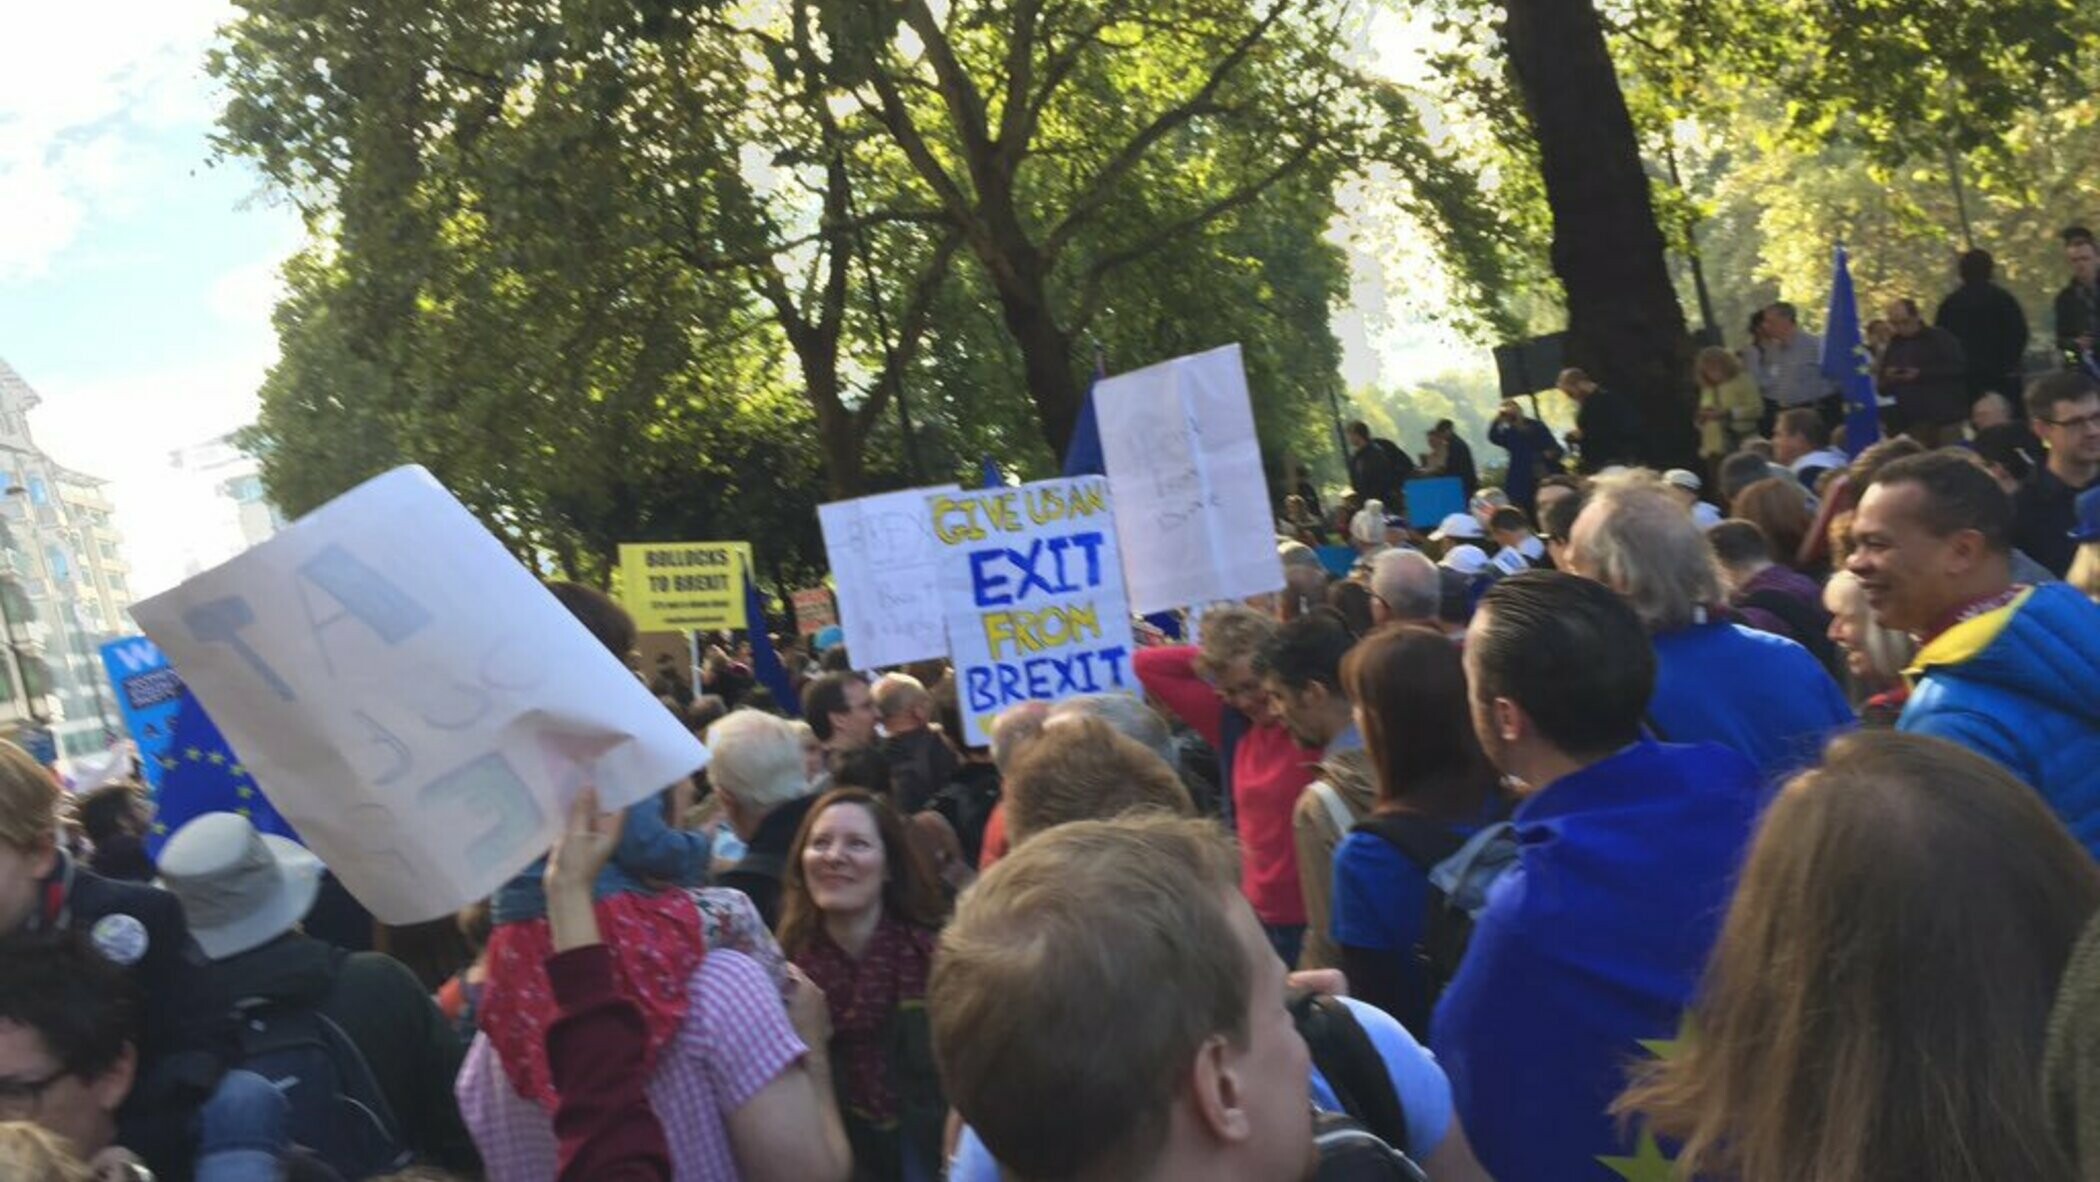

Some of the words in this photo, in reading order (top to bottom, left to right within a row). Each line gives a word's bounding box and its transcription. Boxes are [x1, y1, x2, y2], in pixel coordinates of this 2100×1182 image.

[931, 494, 1023, 545] GIVE
[1025, 488, 1067, 526] US
[646, 549, 729, 567] BOLLOCKS
[648, 575, 669, 592] TO
[674, 574, 729, 592] BREXIT
[969, 531, 1104, 606] EXIT
[981, 602, 1102, 661] FROM
[966, 646, 1128, 713] BREXIT
